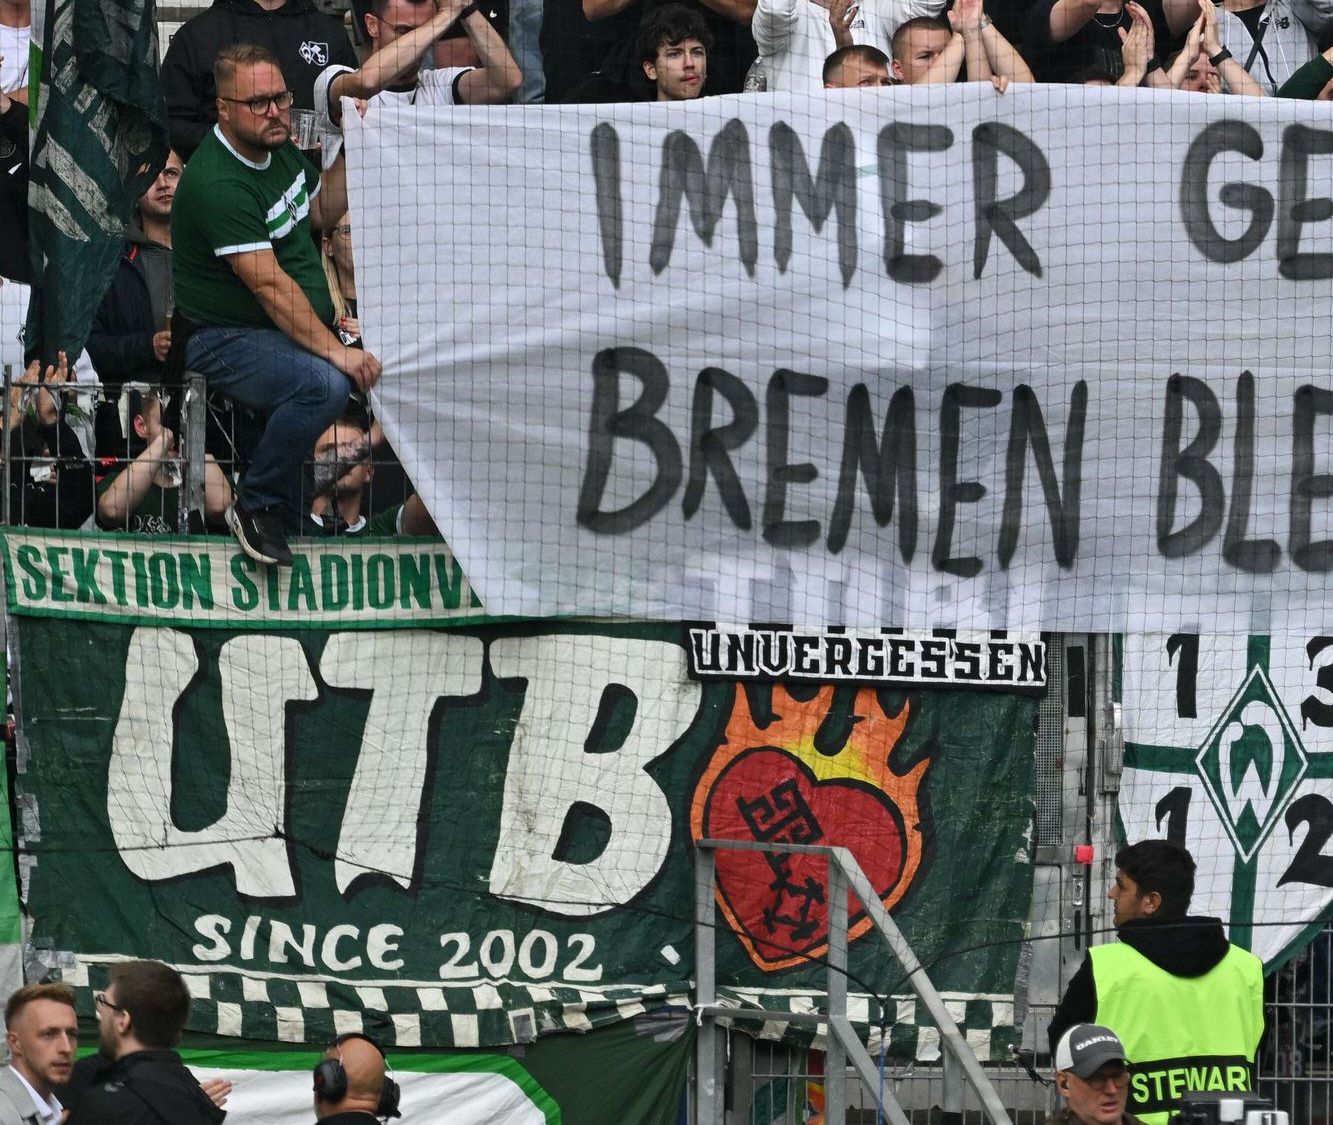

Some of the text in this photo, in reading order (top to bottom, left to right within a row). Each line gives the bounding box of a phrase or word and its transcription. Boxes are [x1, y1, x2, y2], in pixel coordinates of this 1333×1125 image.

[591, 117, 1053, 289] IMMER
[576, 345, 1087, 577] BREMEN
[15, 543, 485, 612] SEKTION STADIONV
[692, 629, 1047, 686] UNVERGESSEN
[107, 626, 702, 917] UTB
[192, 914, 604, 981] SINCE 2002
[1075, 1035, 1118, 1051] OAKLEY
[1131, 1066, 1252, 1104] STEWAR
